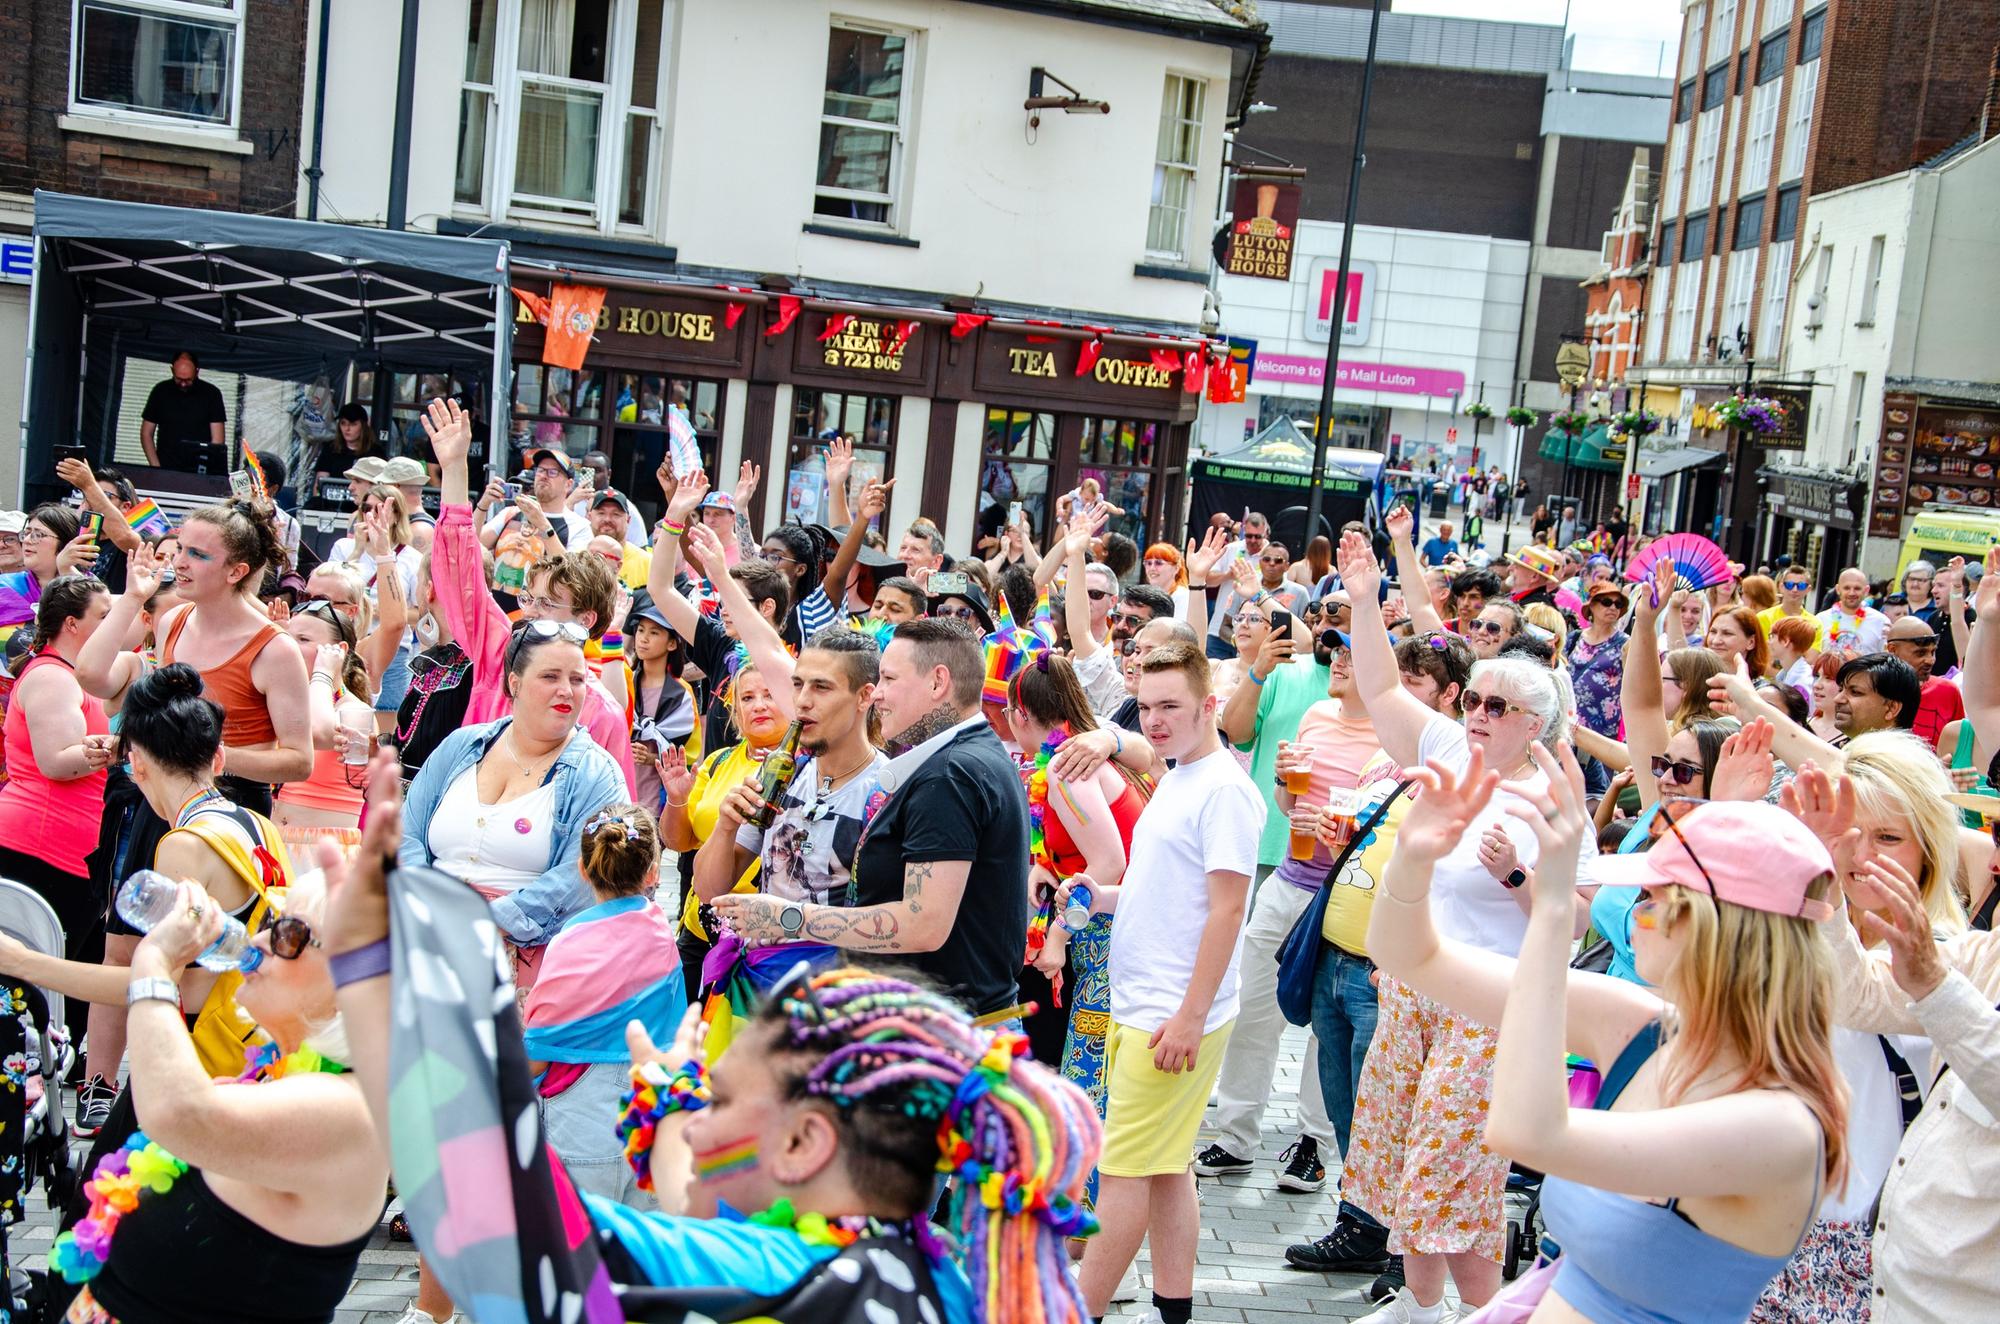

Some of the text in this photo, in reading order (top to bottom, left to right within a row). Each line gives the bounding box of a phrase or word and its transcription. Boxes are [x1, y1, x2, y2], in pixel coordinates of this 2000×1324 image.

[1233, 233, 1290, 252] LUTON
[1233, 247, 1287, 264] KEBAB
[1229, 259, 1287, 277] HOUSE
[617, 306, 715, 342] HOUSE
[860, 321, 880, 338] IN
[843, 351, 872, 369] 722
[1009, 348, 1172, 389] TEA COFFEE
[1254, 359, 1305, 377] Welcome
[1308, 364, 1322, 378] to
[1350, 368, 1377, 383] Mall
[1380, 371, 1416, 387] Luton
